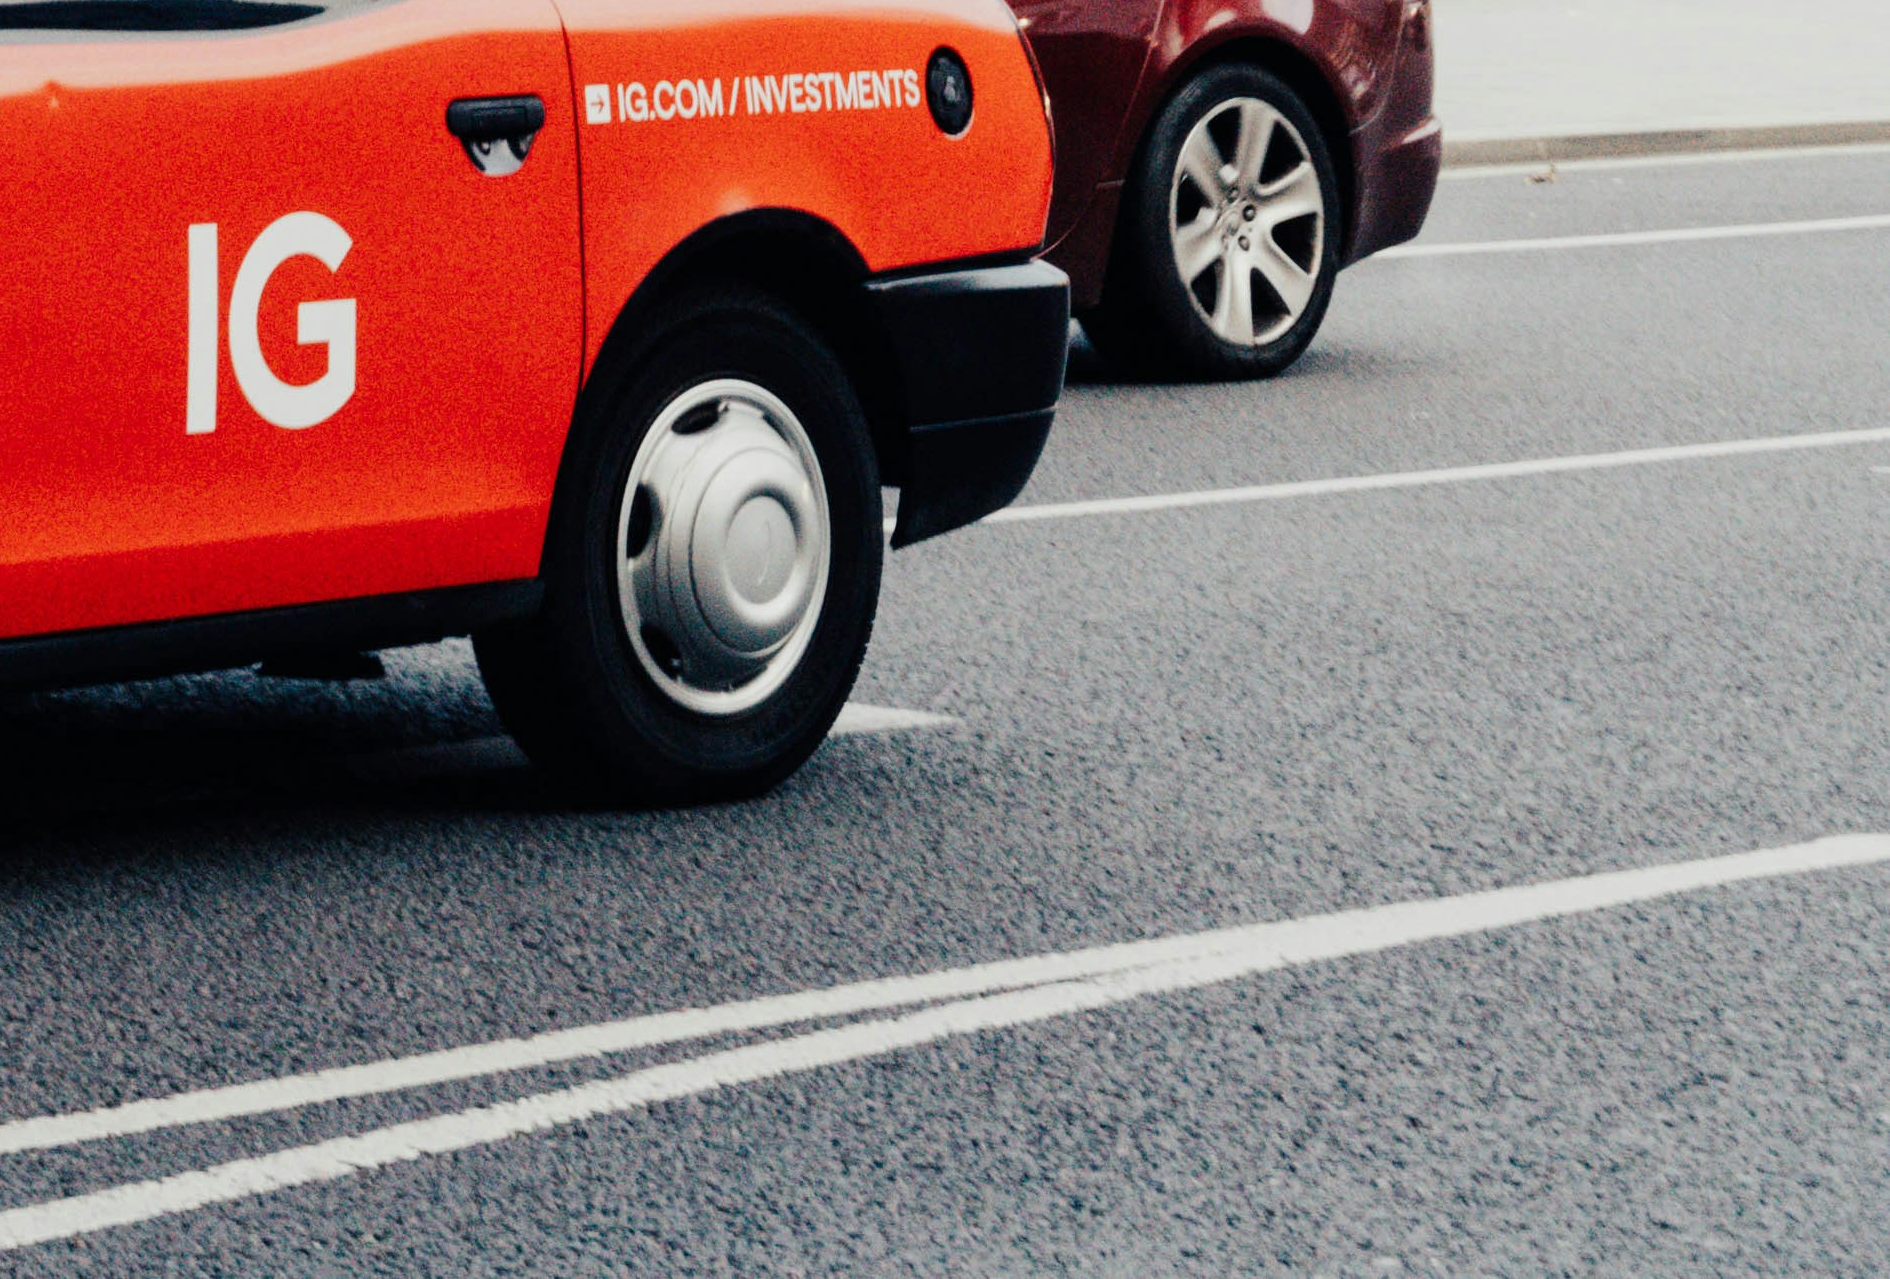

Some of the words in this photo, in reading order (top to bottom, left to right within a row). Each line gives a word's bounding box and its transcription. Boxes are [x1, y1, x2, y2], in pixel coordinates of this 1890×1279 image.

[617, 77, 724, 122] IG.COM
[744, 68, 921, 117] INVESTMENTS
[186, 210, 357, 435] IG
